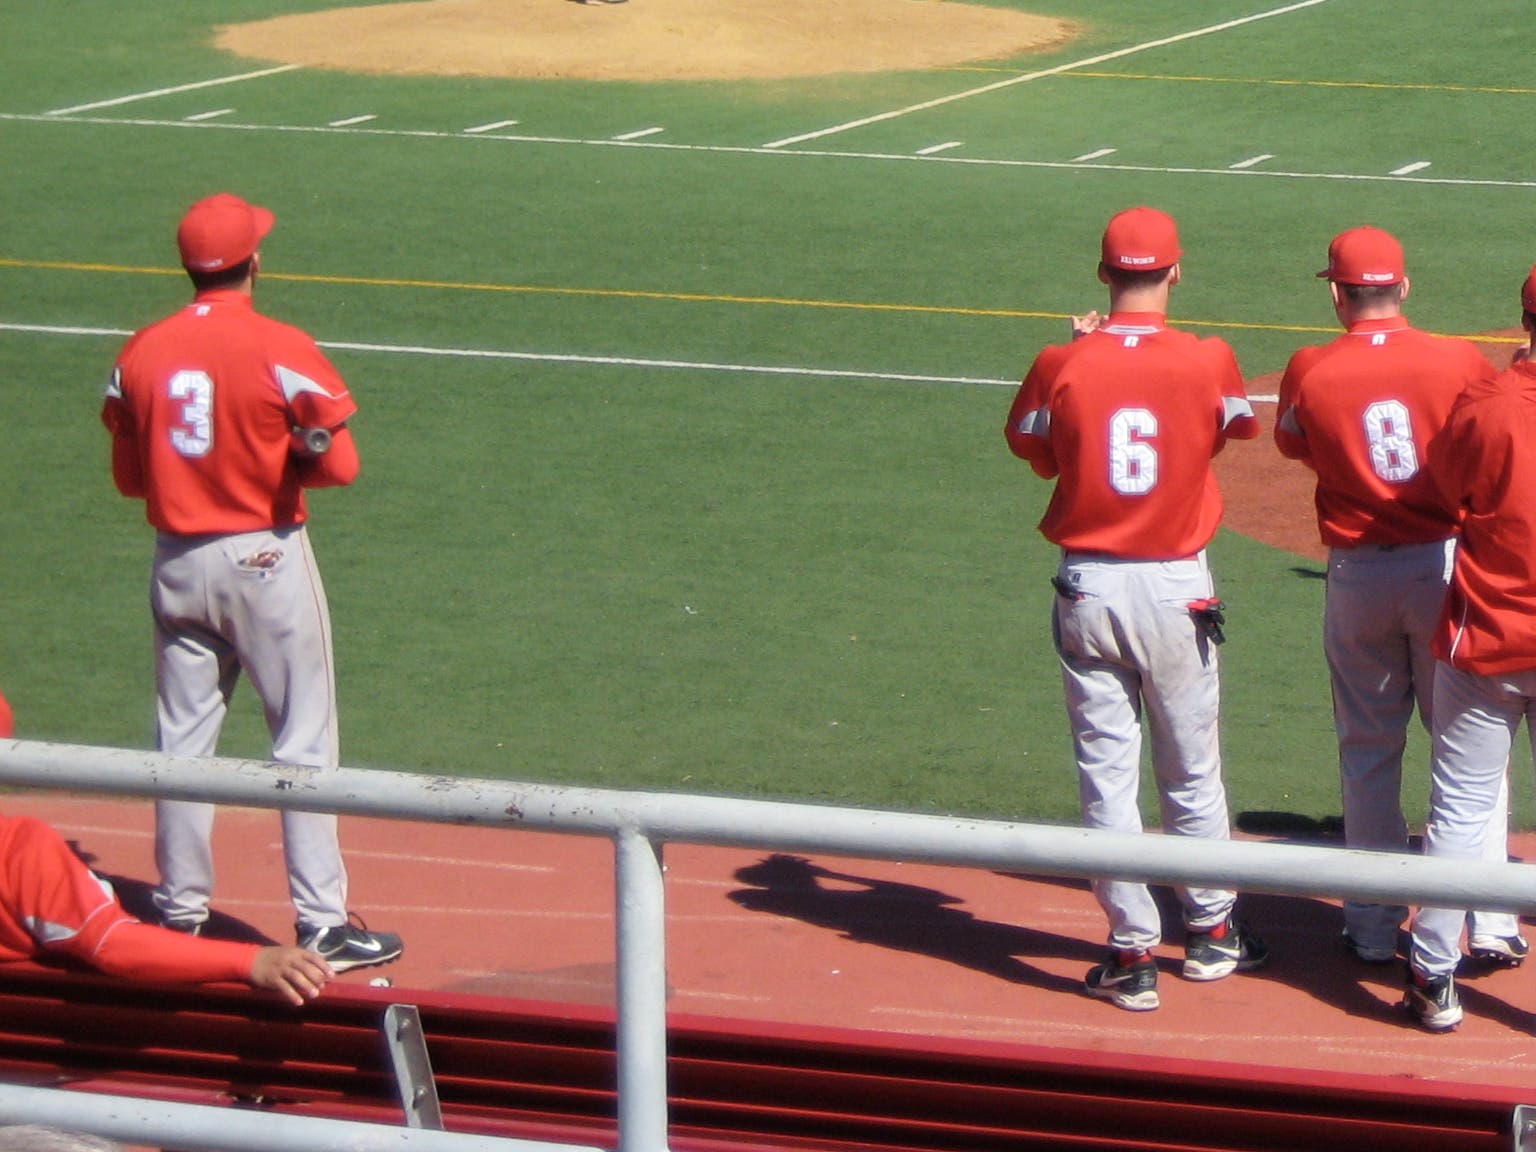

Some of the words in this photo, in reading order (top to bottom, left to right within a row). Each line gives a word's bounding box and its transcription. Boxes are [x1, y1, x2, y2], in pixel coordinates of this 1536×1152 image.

[169, 370, 214, 457] 3
[1108, 407, 1159, 497] 6
[1363, 399, 1419, 483] 8
